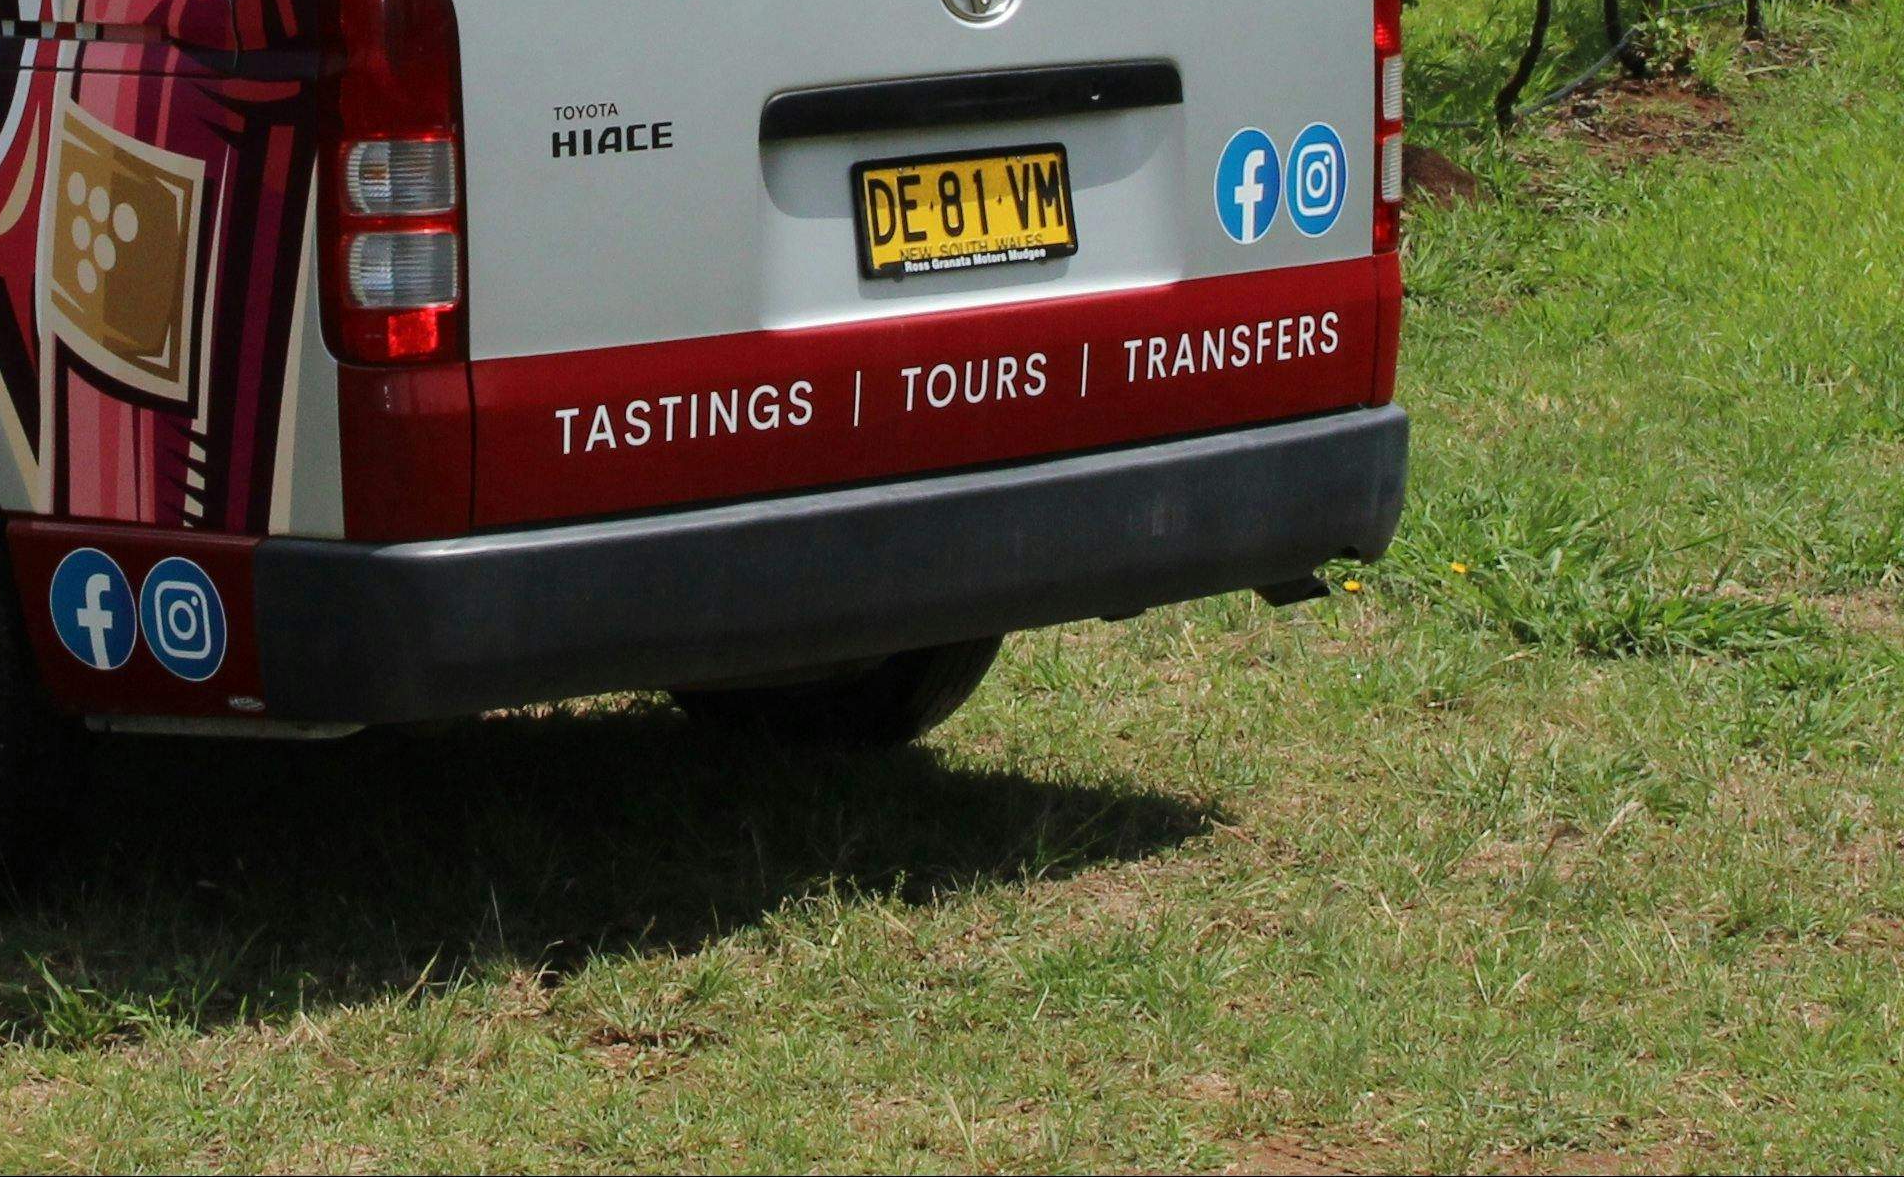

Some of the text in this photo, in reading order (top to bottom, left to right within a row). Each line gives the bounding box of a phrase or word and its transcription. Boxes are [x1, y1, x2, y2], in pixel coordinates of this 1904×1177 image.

[553, 103, 619, 121] TOYOTA
[552, 121, 674, 158] HIACE
[899, 233, 1044, 261] NEW SOUTH WALES
[904, 259, 931, 273] Ross
[973, 251, 1007, 266] Motors
[1008, 247, 1046, 263] Mudgee
[555, 310, 1341, 455] TASTINGS TOURS TRANSFERS
